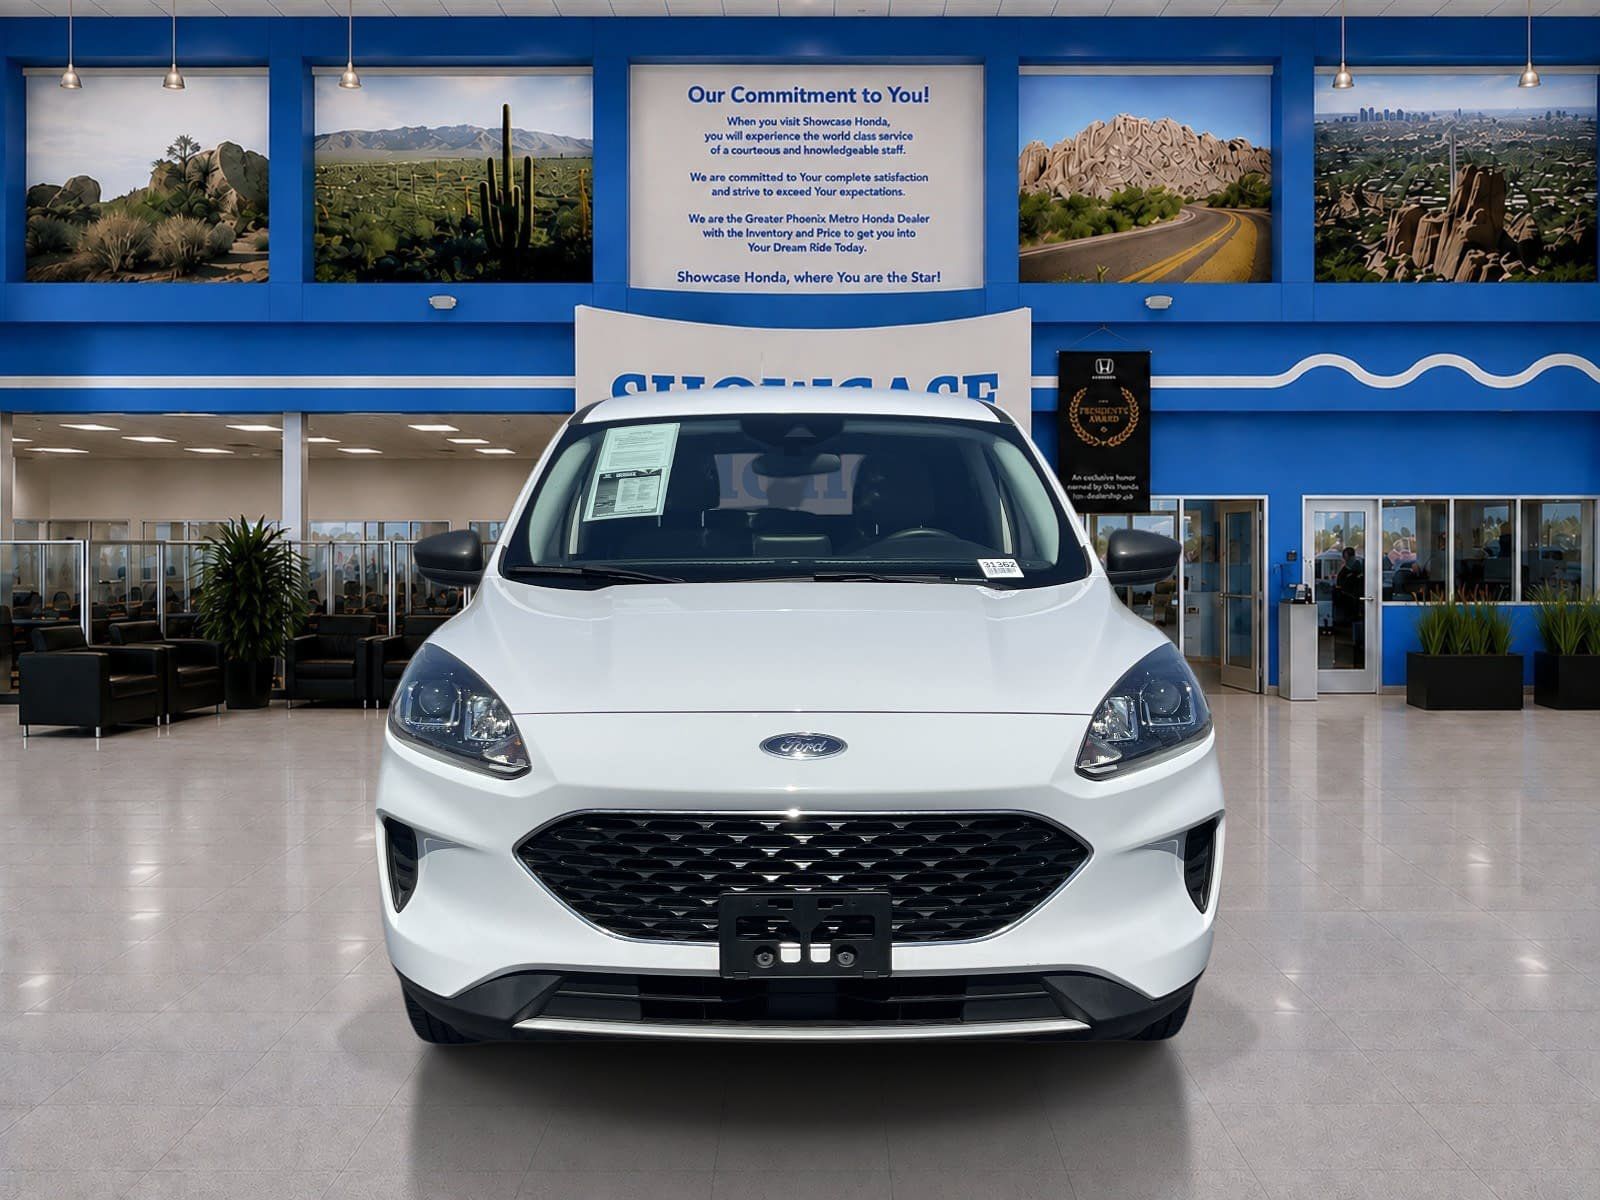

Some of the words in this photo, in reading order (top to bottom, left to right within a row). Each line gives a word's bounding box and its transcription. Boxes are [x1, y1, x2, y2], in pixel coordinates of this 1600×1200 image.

[688, 86, 726, 103] Our
[731, 86, 857, 103] Commitment
[861, 88, 882, 103] to
[887, 86, 929, 103] You!
[727, 116, 756, 126] When
[759, 119, 777, 128] you
[780, 117, 800, 126] visit
[803, 116, 852, 126] Showcase
[855, 117, 890, 128] Honda,
[705, 133, 723, 143] you
[726, 131, 743, 140] will
[746, 131, 800, 143] experience
[803, 131, 819, 140] the
[822, 131, 851, 141] world
[853, 131, 876, 141] class
[879, 131, 913, 141] service
[710, 145, 721, 154] of
[731, 147, 781, 155] courteous
[783, 145, 801, 154] and
[882, 145, 906, 154] staff.
[690, 172, 707, 182] We
[729, 172, 783, 182] committed
[786, 174, 797, 182] to
[800, 172, 822, 182] Your
[825, 173, 871, 184] complete
[874, 172, 928, 182] satisfaction
[712, 186, 730, 196] and
[733, 187, 760, 196] strive
[763, 188, 773, 196] to
[776, 187, 811, 196] exceed
[814, 187, 837, 196] Your
[840, 187, 905, 199] expectations.
[689, 214, 705, 223] We
[726, 214, 743, 223] the
[745, 214, 784, 223] Greater
[786, 214, 826, 223] Phoenix
[829, 214, 859, 223] Metro
[862, 214, 894, 223] Honda
[898, 214, 930, 223] Dealer
[703, 228, 724, 237] with
[727, 228, 743, 238] the
[746, 228, 793, 240] Inventory
[795, 228, 814, 238] and
[817, 228, 841, 238] Price
[857, 230, 874, 240] get
[876, 231, 894, 240] you
[897, 228, 916, 238] into
[748, 243, 771, 252] Your
[773, 243, 807, 252] Dream
[810, 243, 832, 252] Ride
[834, 243, 867, 254] Today.
[677, 271, 740, 283] Showcase
[745, 271, 789, 285] Honda,
[794, 271, 833, 283] where
[837, 272, 860, 283] You
[864, 274, 883, 283] are
[887, 271, 907, 283] the
[911, 271, 940, 283] Star!
[779, 737, 827, 752] Ford
